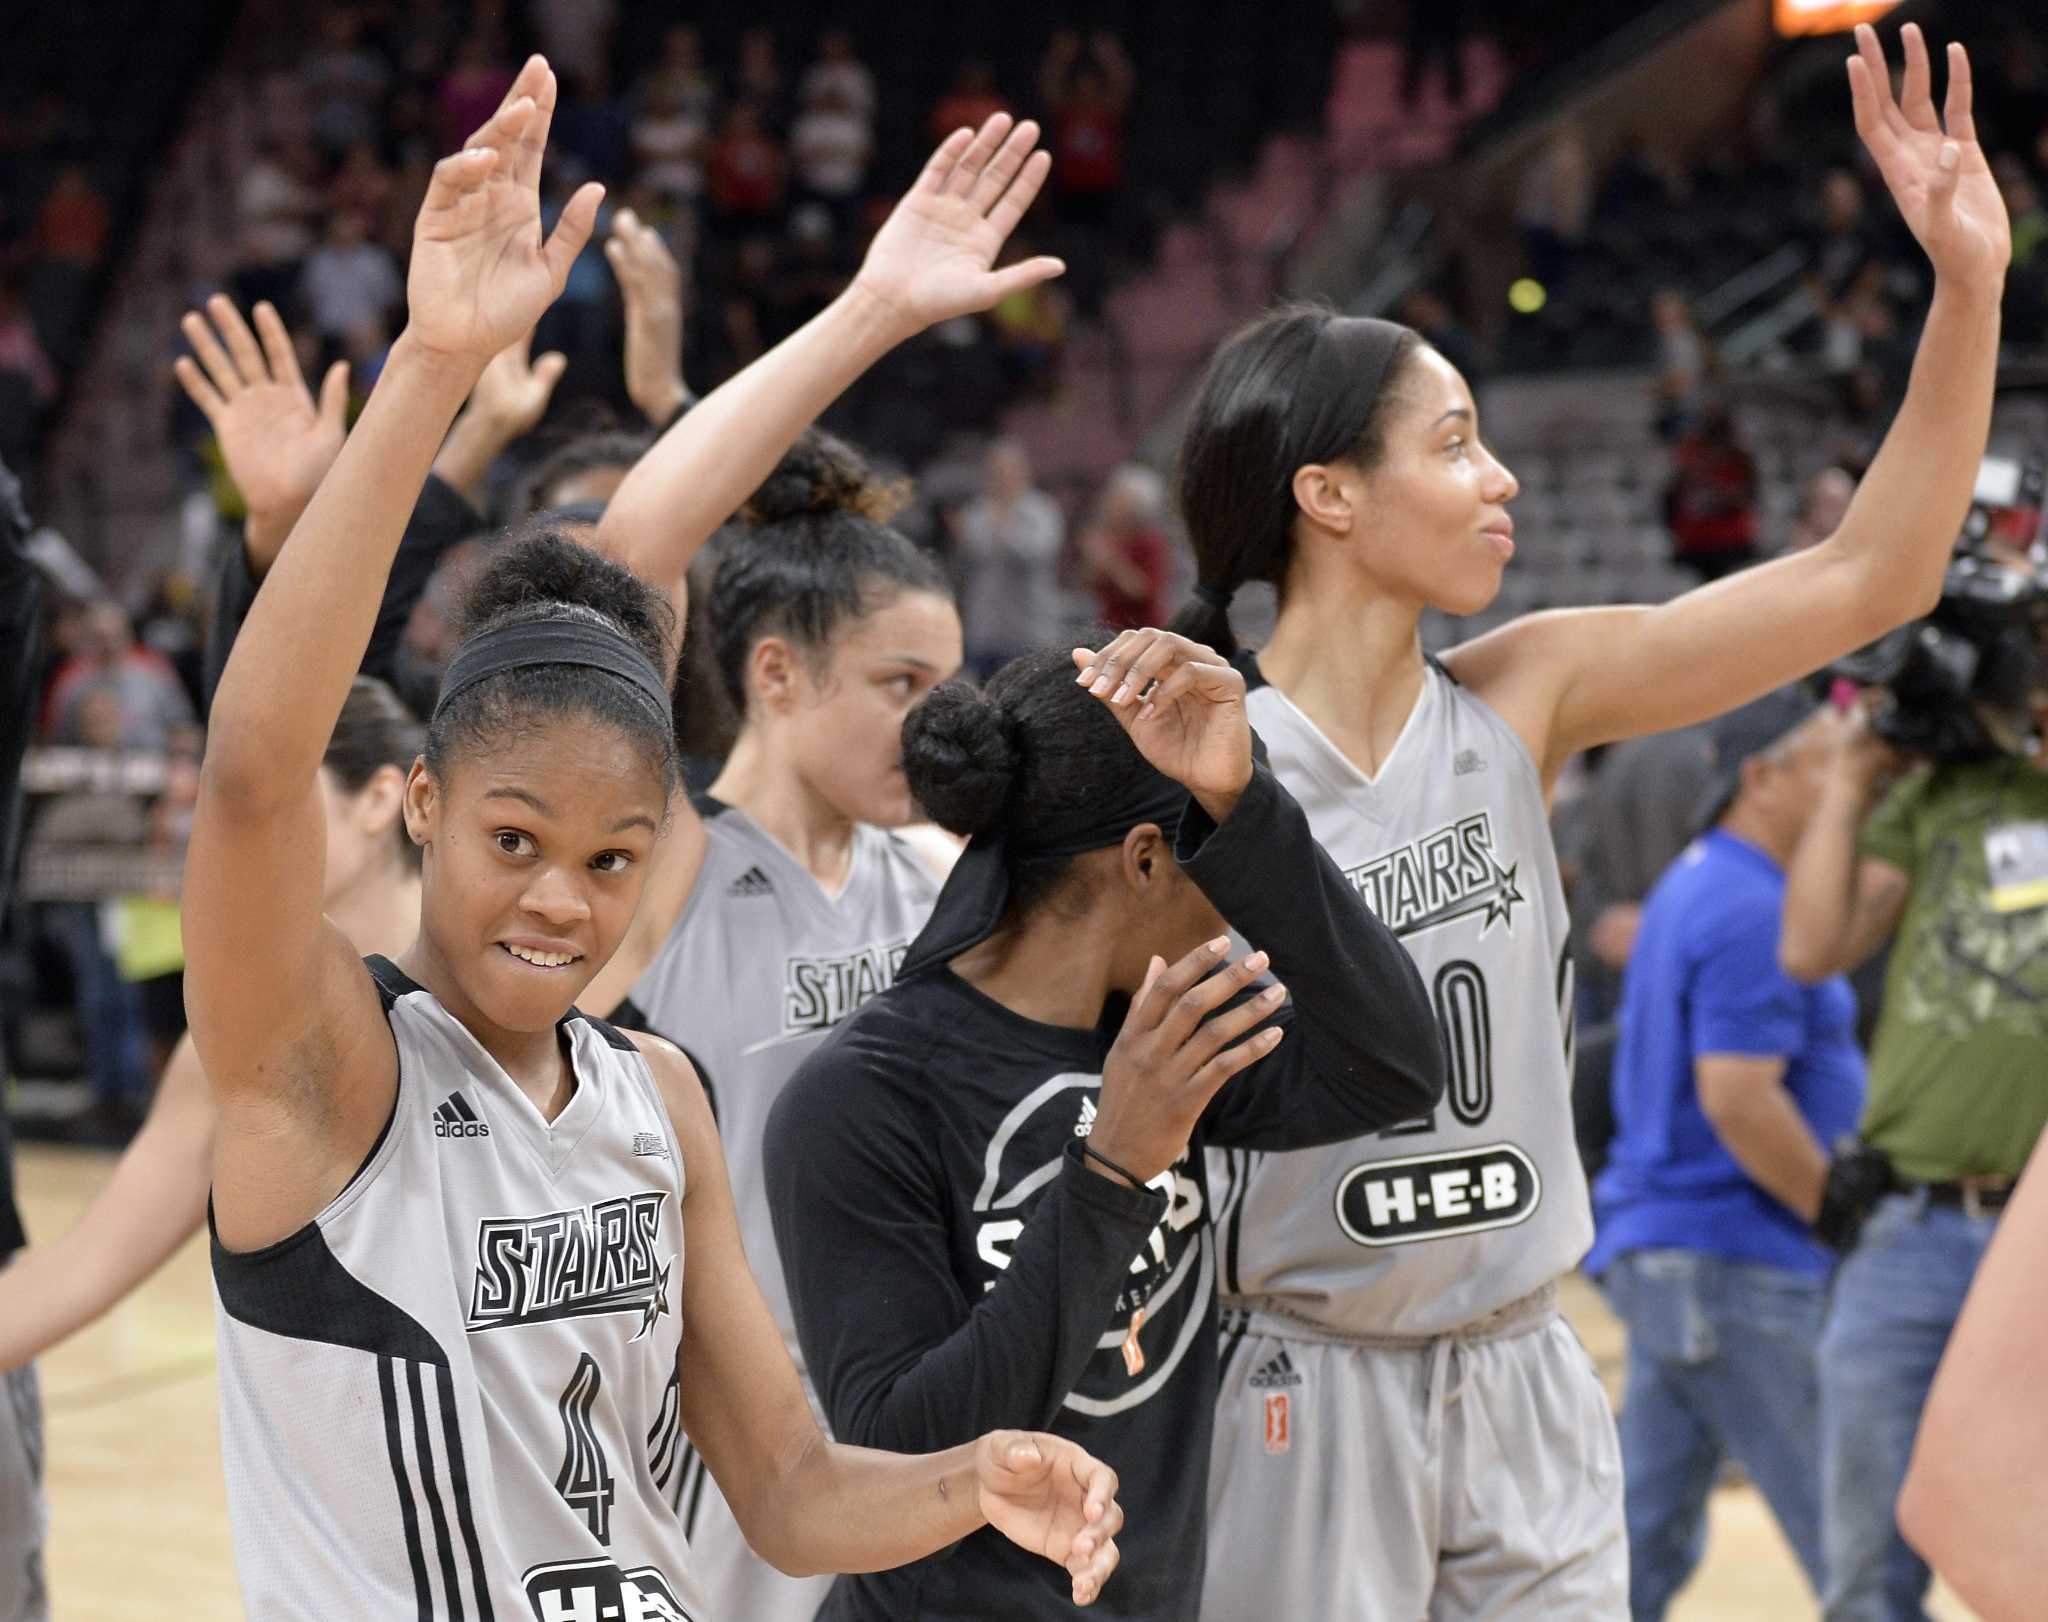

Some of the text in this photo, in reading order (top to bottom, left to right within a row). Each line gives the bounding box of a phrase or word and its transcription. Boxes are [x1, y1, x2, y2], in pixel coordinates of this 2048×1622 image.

[1345, 811, 1496, 930] TARS
[433, 1120, 490, 1138] didas
[467, 1190, 671, 1325] STARS
[554, 1351, 616, 1548] 4
